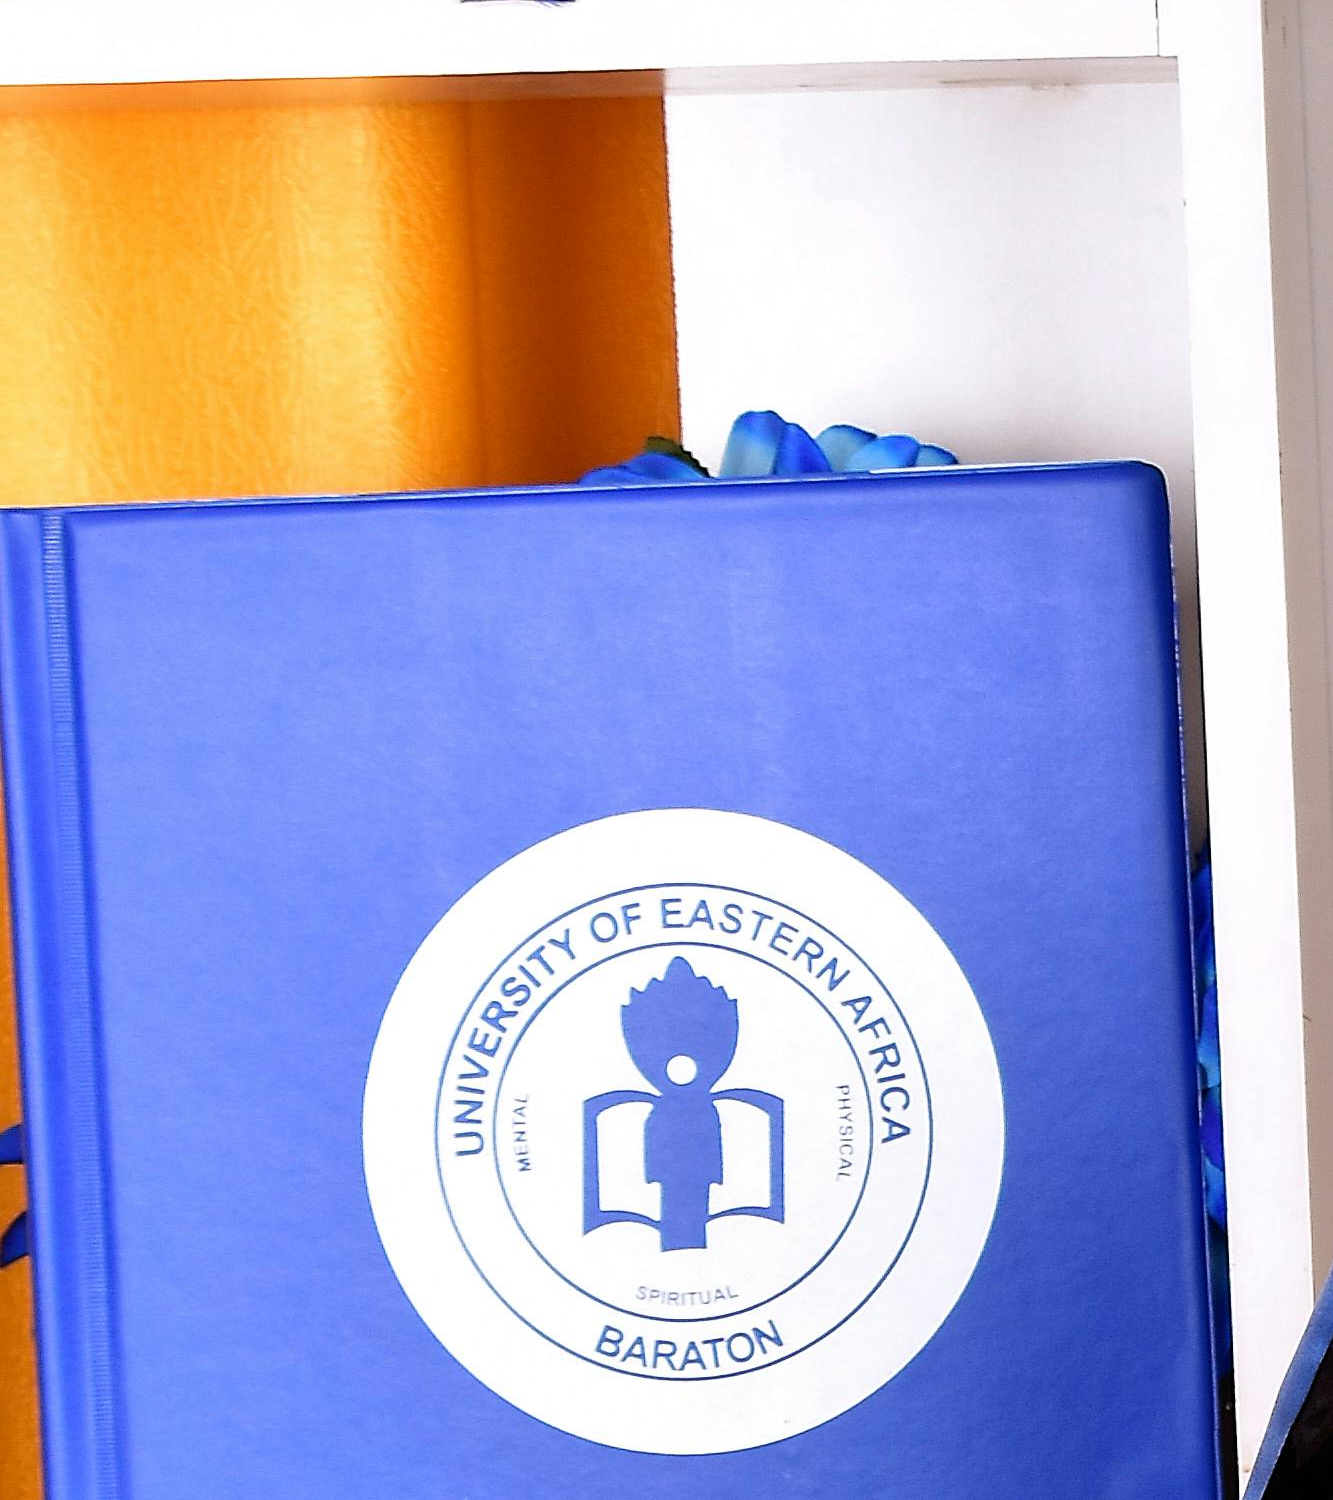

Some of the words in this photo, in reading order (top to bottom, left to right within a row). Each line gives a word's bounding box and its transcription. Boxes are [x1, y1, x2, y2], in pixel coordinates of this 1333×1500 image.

[454, 928, 576, 1157] UNIVERSITY
[589, 902, 643, 943] OF
[661, 898, 851, 991] EASTERN
[841, 994, 911, 1145] AFRICA
[517, 1093, 533, 1173] MENTAL
[836, 1084, 855, 1182] PHYSICAL
[635, 1284, 740, 1307] SPIRITUAL
[594, 1319, 785, 1372] BARATON
